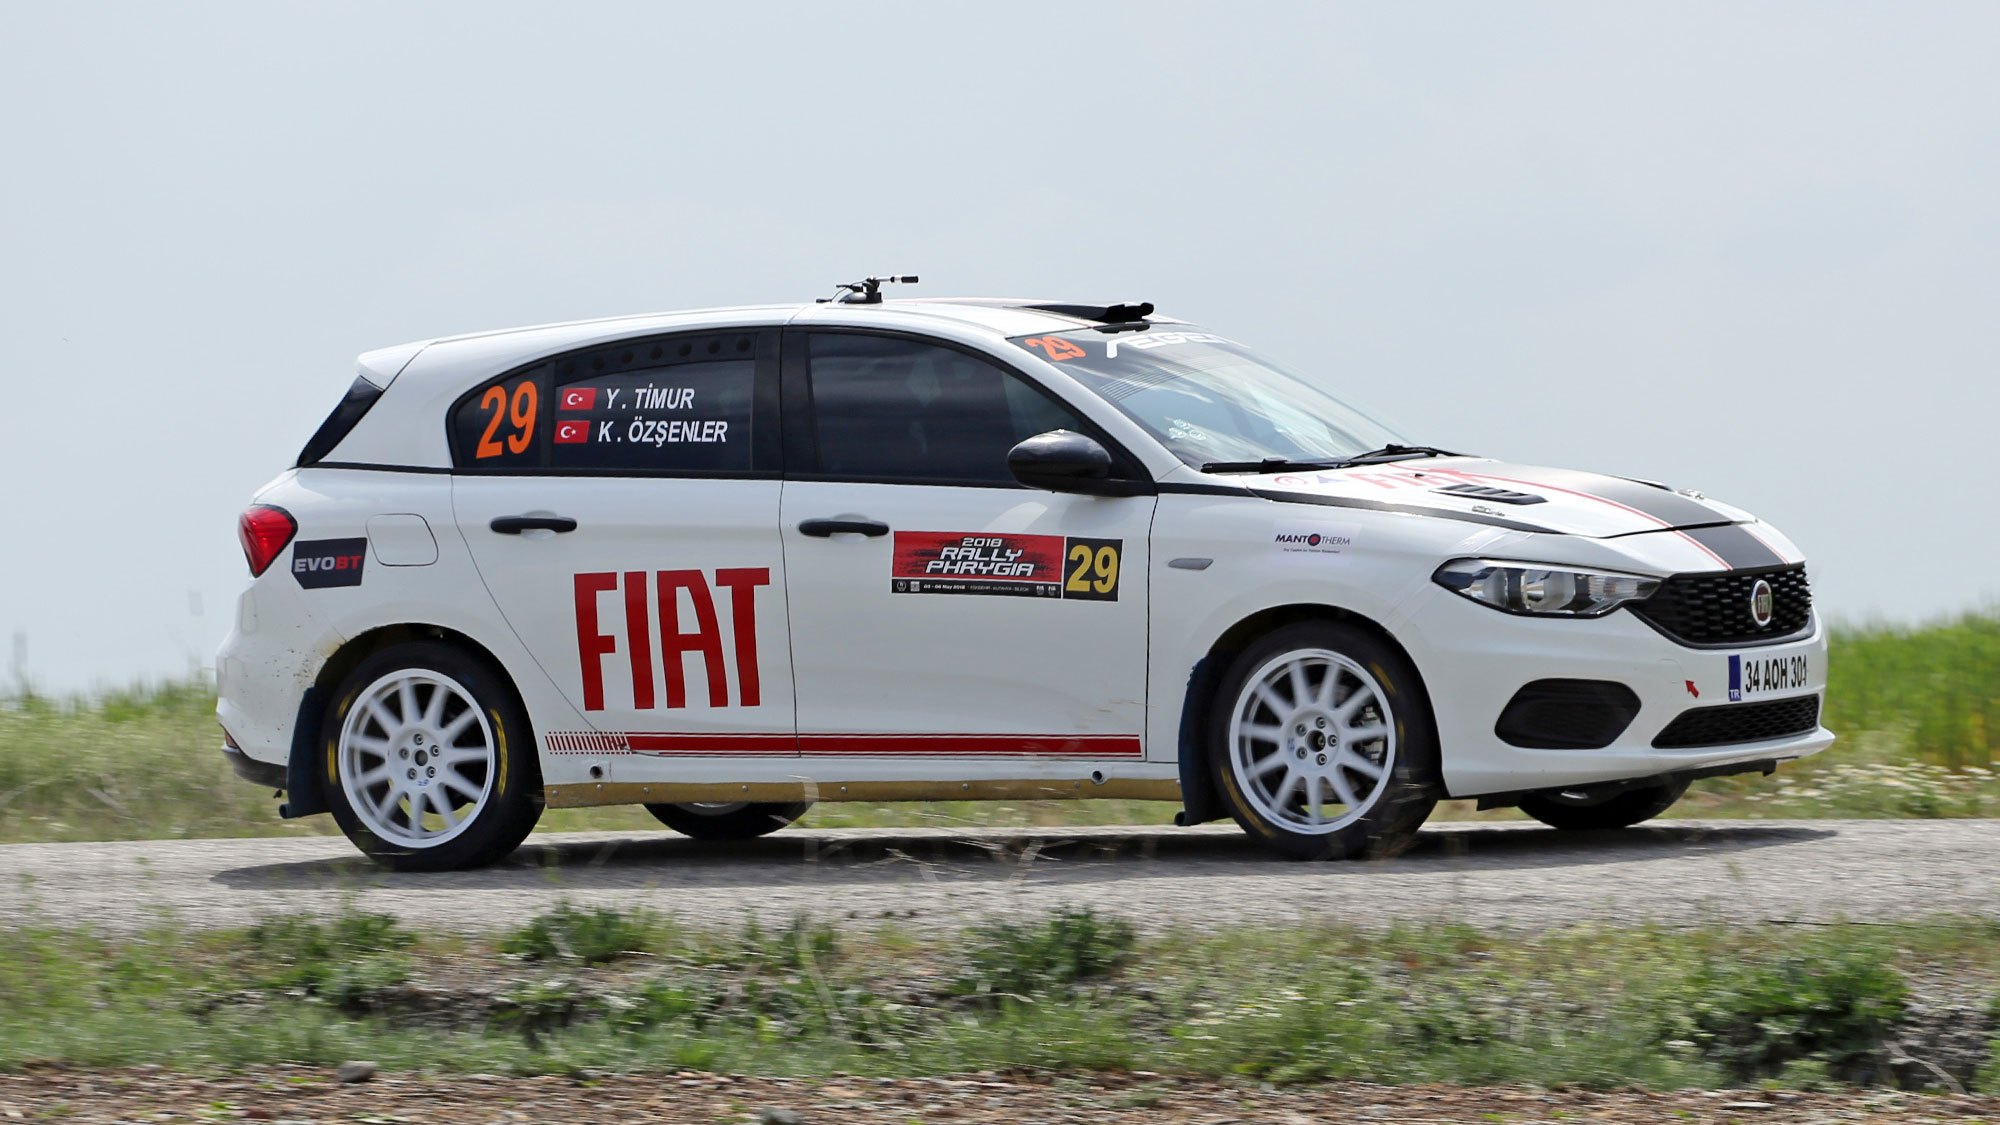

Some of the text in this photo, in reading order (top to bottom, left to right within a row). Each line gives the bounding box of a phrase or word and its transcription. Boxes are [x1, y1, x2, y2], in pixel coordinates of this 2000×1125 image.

[1024, 335, 1087, 361] 29
[635, 382, 695, 409] TİMUR
[476, 380, 538, 459] 29
[628, 416, 728, 447] ÖZŞENLER
[939, 547, 1024, 562] RALLY
[962, 537, 1003, 548] 2018
[294, 555, 362, 572] EVOBT
[925, 560, 1035, 577] PHRYGIA
[1065, 544, 1119, 594] 29
[574, 567, 770, 711] FIAT
[1745, 660, 1760, 693] 34
[1763, 657, 1787, 691] AOH
[1729, 689, 1740, 699] TR
